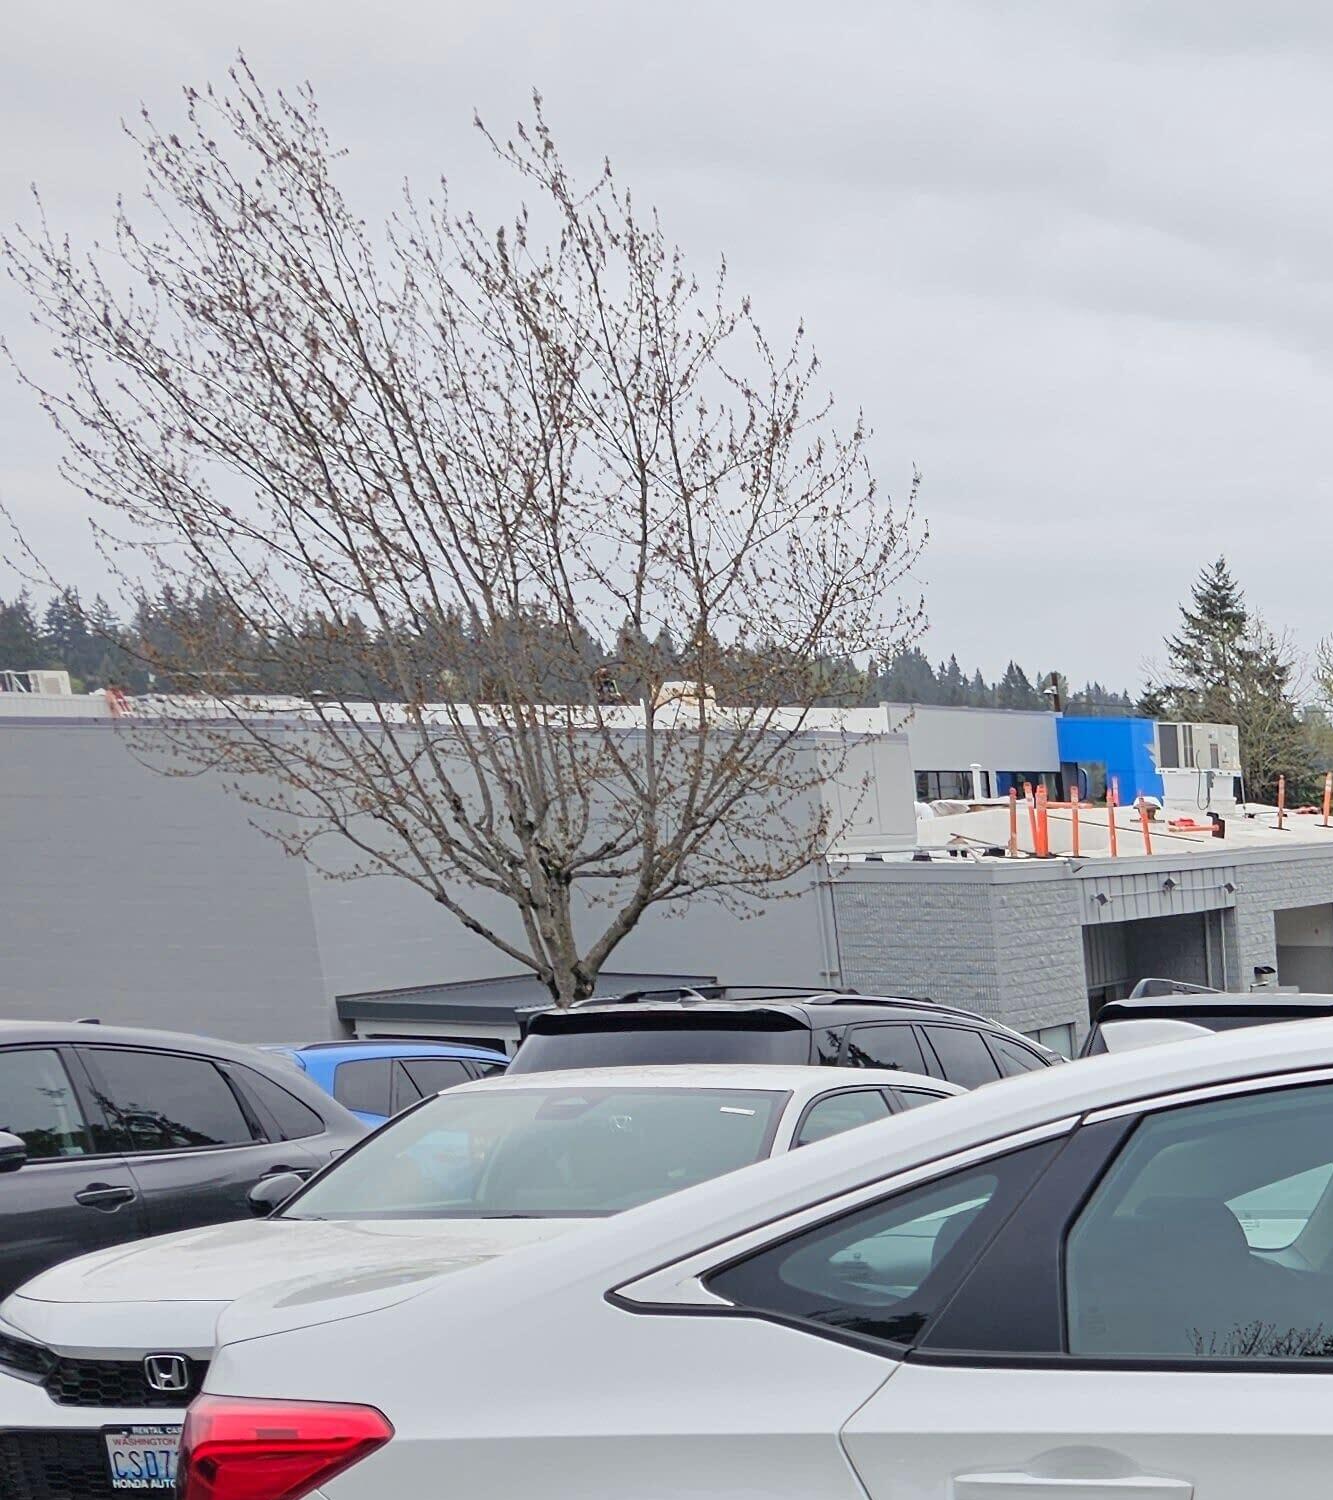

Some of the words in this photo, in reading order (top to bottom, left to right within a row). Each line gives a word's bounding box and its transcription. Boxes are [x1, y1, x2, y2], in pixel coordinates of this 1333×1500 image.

[132, 1426, 164, 1434] RENTAL
[113, 1438, 176, 1446] WASHINGTON
[113, 1450, 178, 1478] CSD7
[112, 1479, 150, 1489] HONDA
